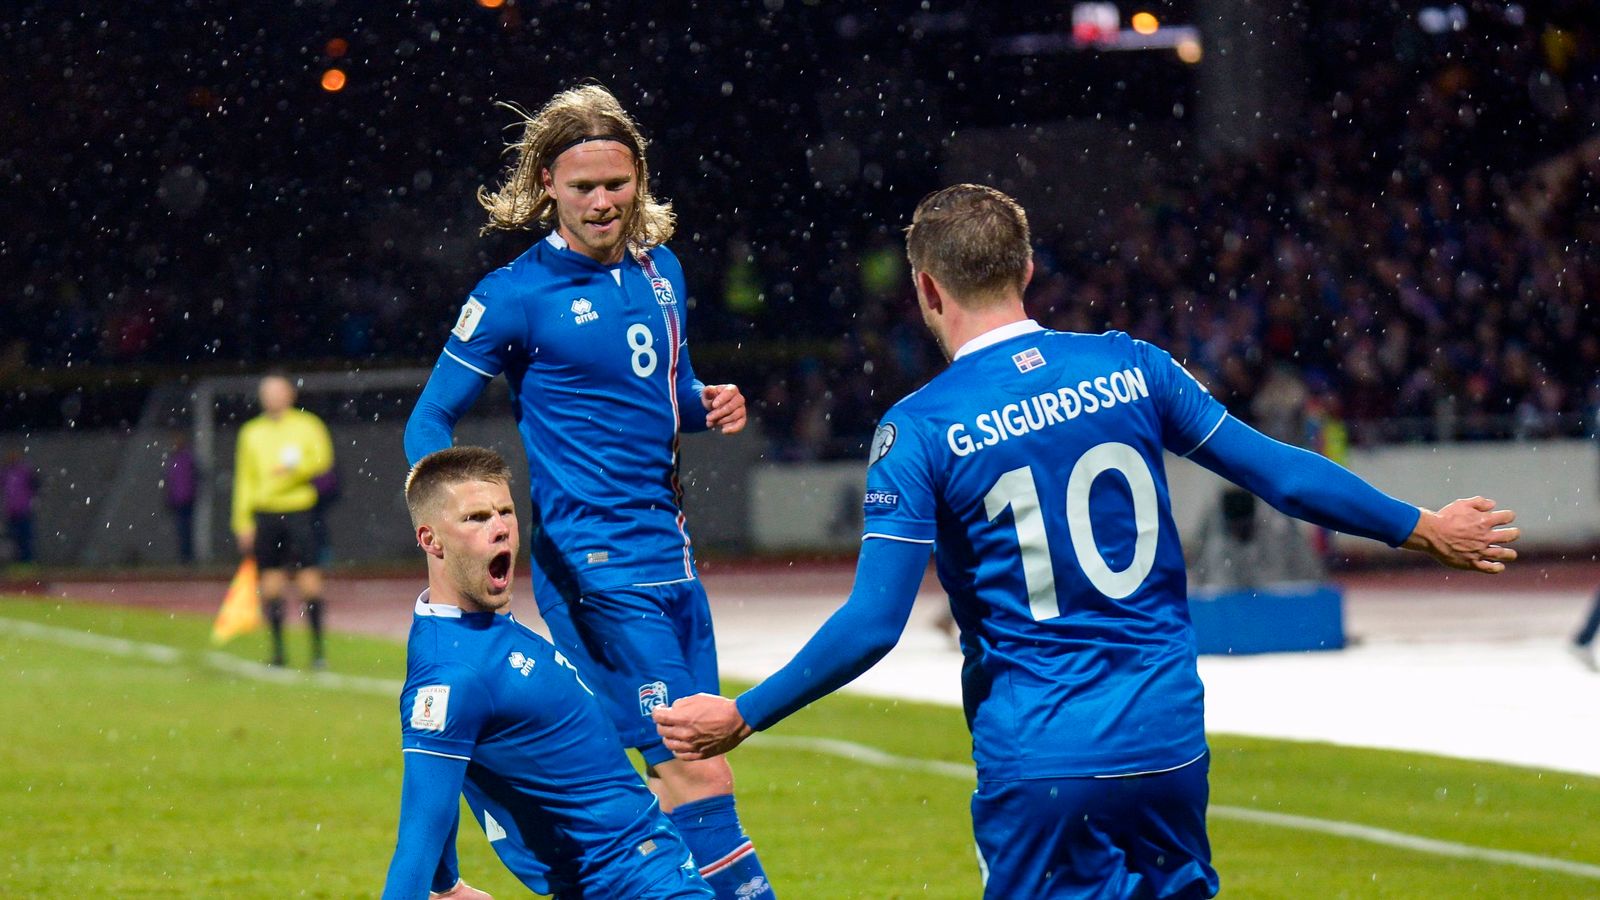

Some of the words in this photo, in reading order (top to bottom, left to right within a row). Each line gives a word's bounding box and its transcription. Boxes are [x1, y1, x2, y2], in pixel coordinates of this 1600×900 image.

[626, 323, 658, 378] 8
[865, 493, 898, 504] ESPECT
[983, 441, 1160, 622] 10
